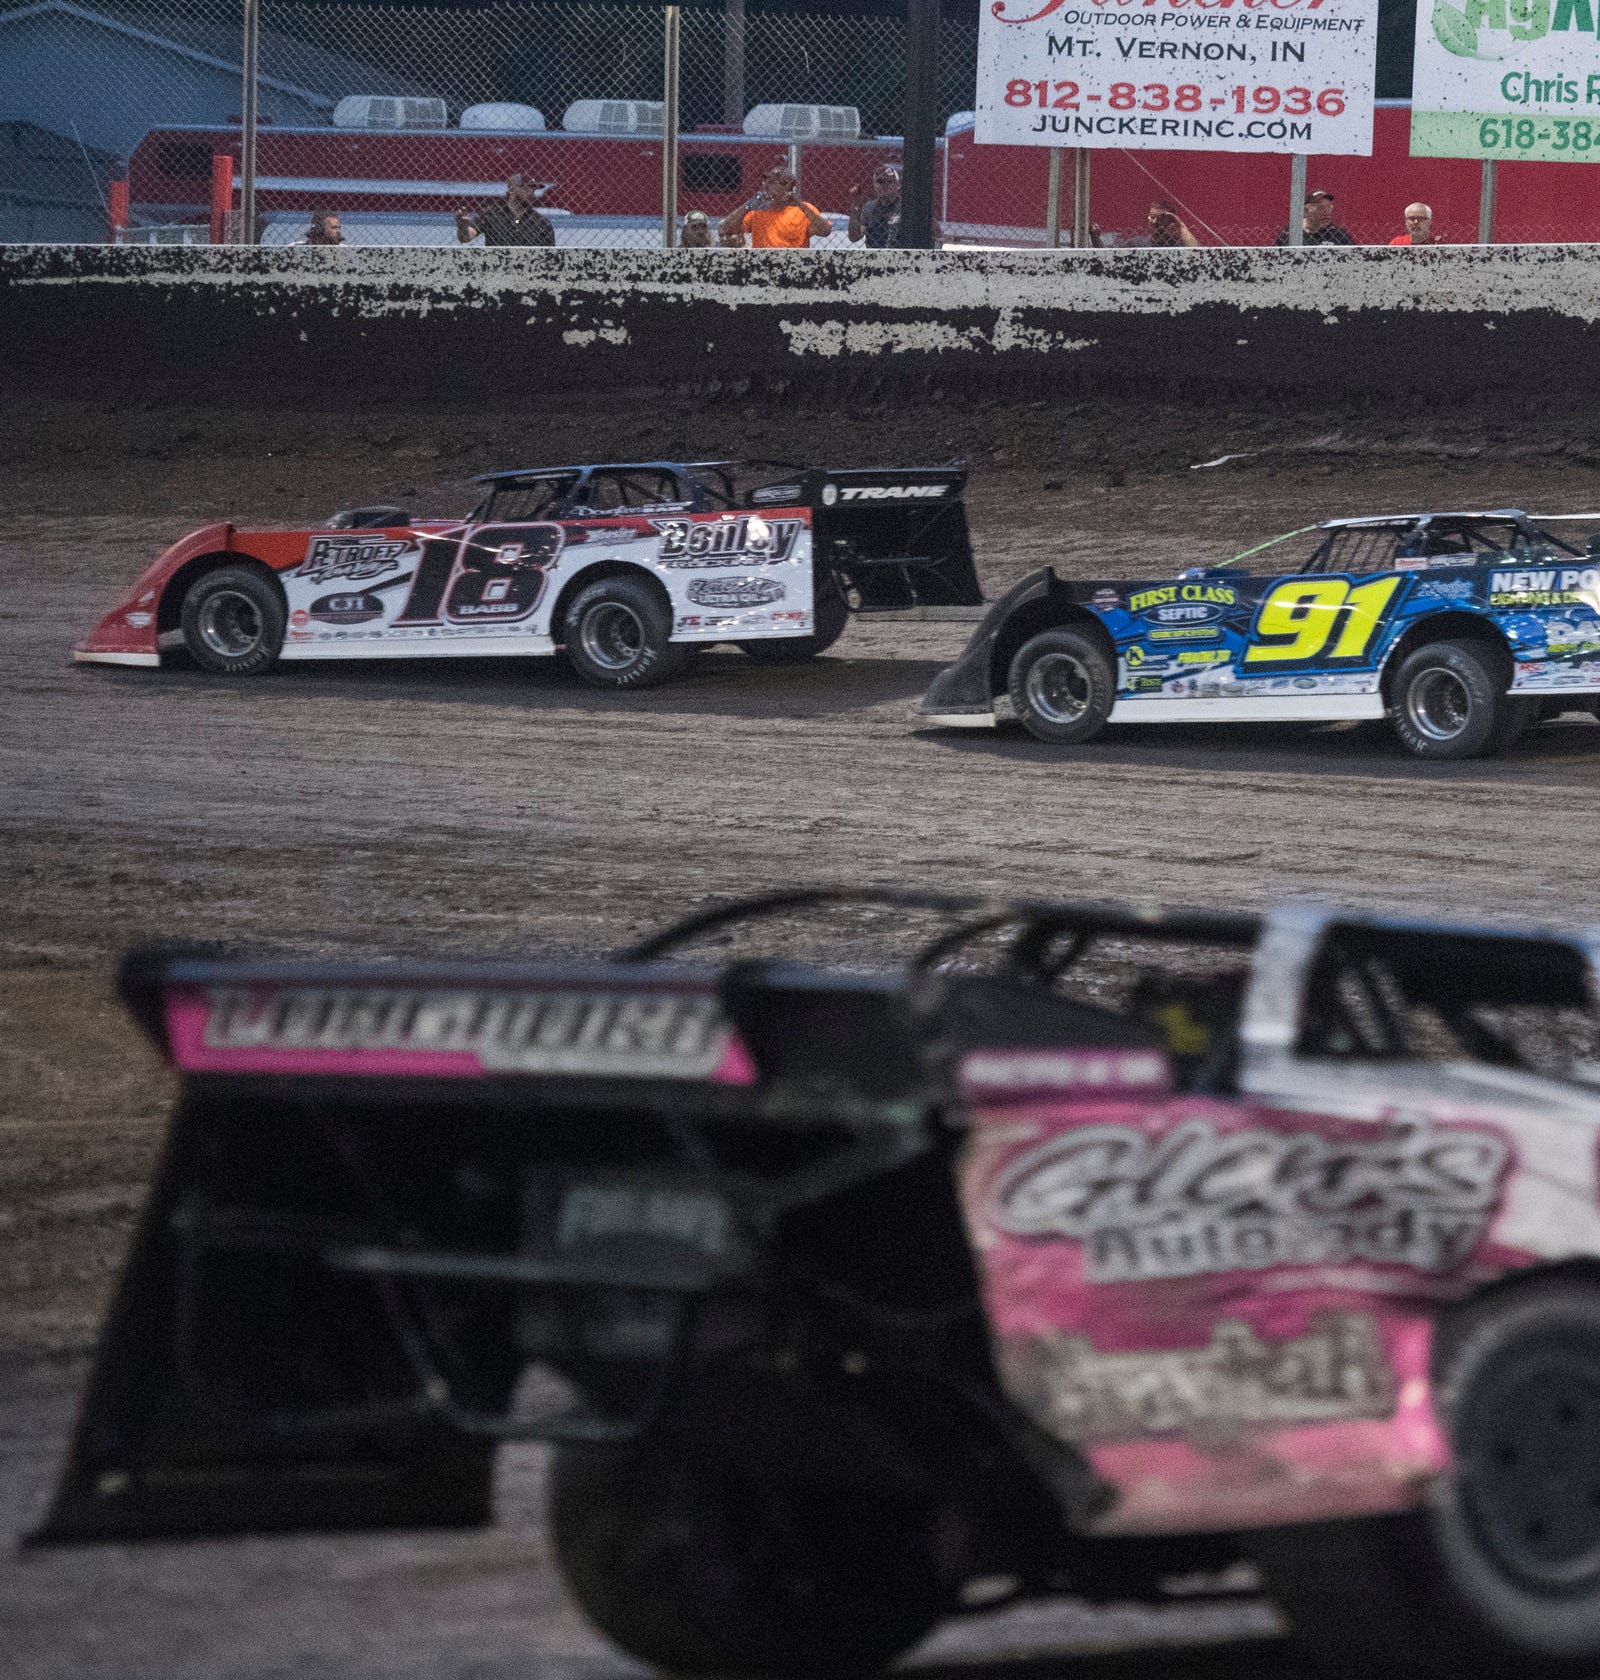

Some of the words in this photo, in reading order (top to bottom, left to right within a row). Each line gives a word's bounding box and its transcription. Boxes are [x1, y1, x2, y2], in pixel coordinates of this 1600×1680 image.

[1065, 10, 1156, 28] OUTDOOR
[1160, 13, 1232, 29] POWER
[1236, 14, 1252, 29] &
[1254, 14, 1366, 34] EQUIPMENT
[1047, 36, 1102, 58] MT.
[1115, 37, 1257, 66] VERNON,
[1271, 41, 1306, 63] IN
[1003, 79, 1346, 117] 812-838-1936
[1500, 71, 1579, 103] Chris
[1032, 114, 1313, 140] JUNCKERINC.COM
[838, 485, 950, 500] TRANE
[391, 520, 566, 628] 18
[1491, 570, 1556, 592] NEW
[1129, 586, 1178, 612] FIRST
[1181, 585, 1236, 605] CLASS
[1157, 606, 1209, 621] SEPTIC
[1245, 576, 1401, 663] 91
